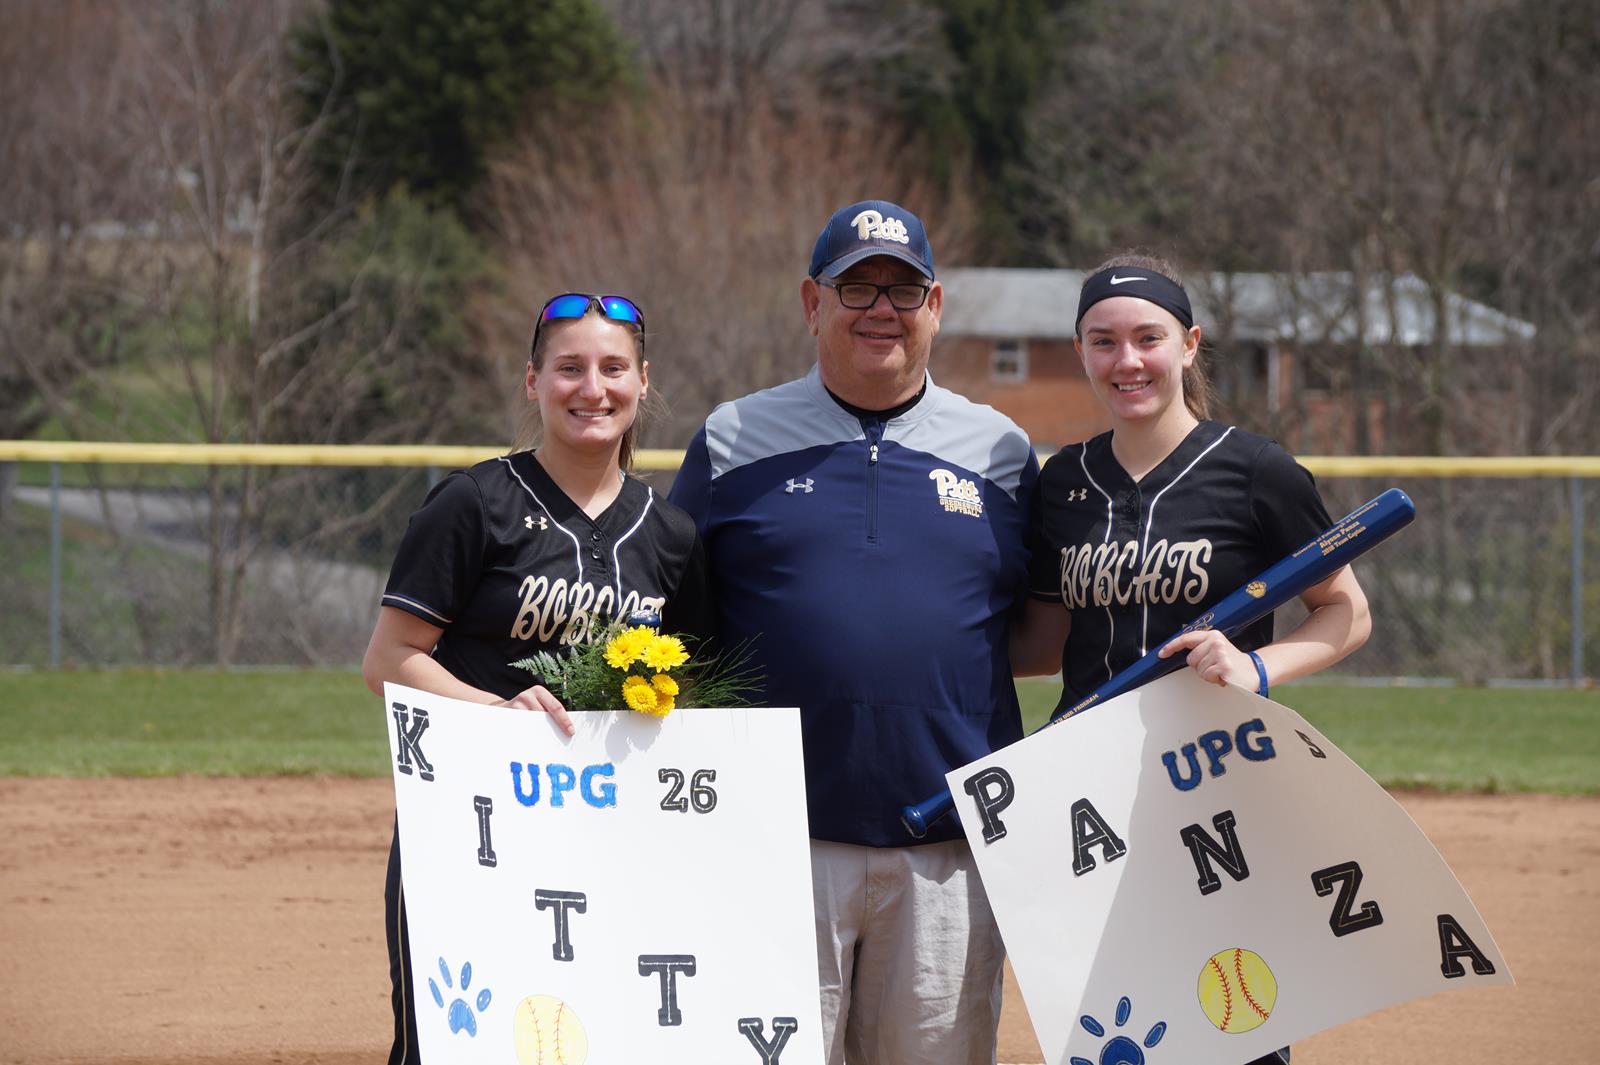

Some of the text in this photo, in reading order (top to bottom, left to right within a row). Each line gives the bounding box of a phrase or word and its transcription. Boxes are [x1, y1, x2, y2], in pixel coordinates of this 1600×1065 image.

[850, 210, 909, 244] Pitt
[929, 469, 981, 503] Pitt
[944, 504, 980, 517] SOFTBALL
[1340, 521, 1360, 535] Panza
[1060, 538, 1212, 609] BOBCATS
[1073, 693, 1099, 712] PROGRAM
[1161, 718, 1276, 791] UPG
[510, 761, 718, 814] UPG 26
